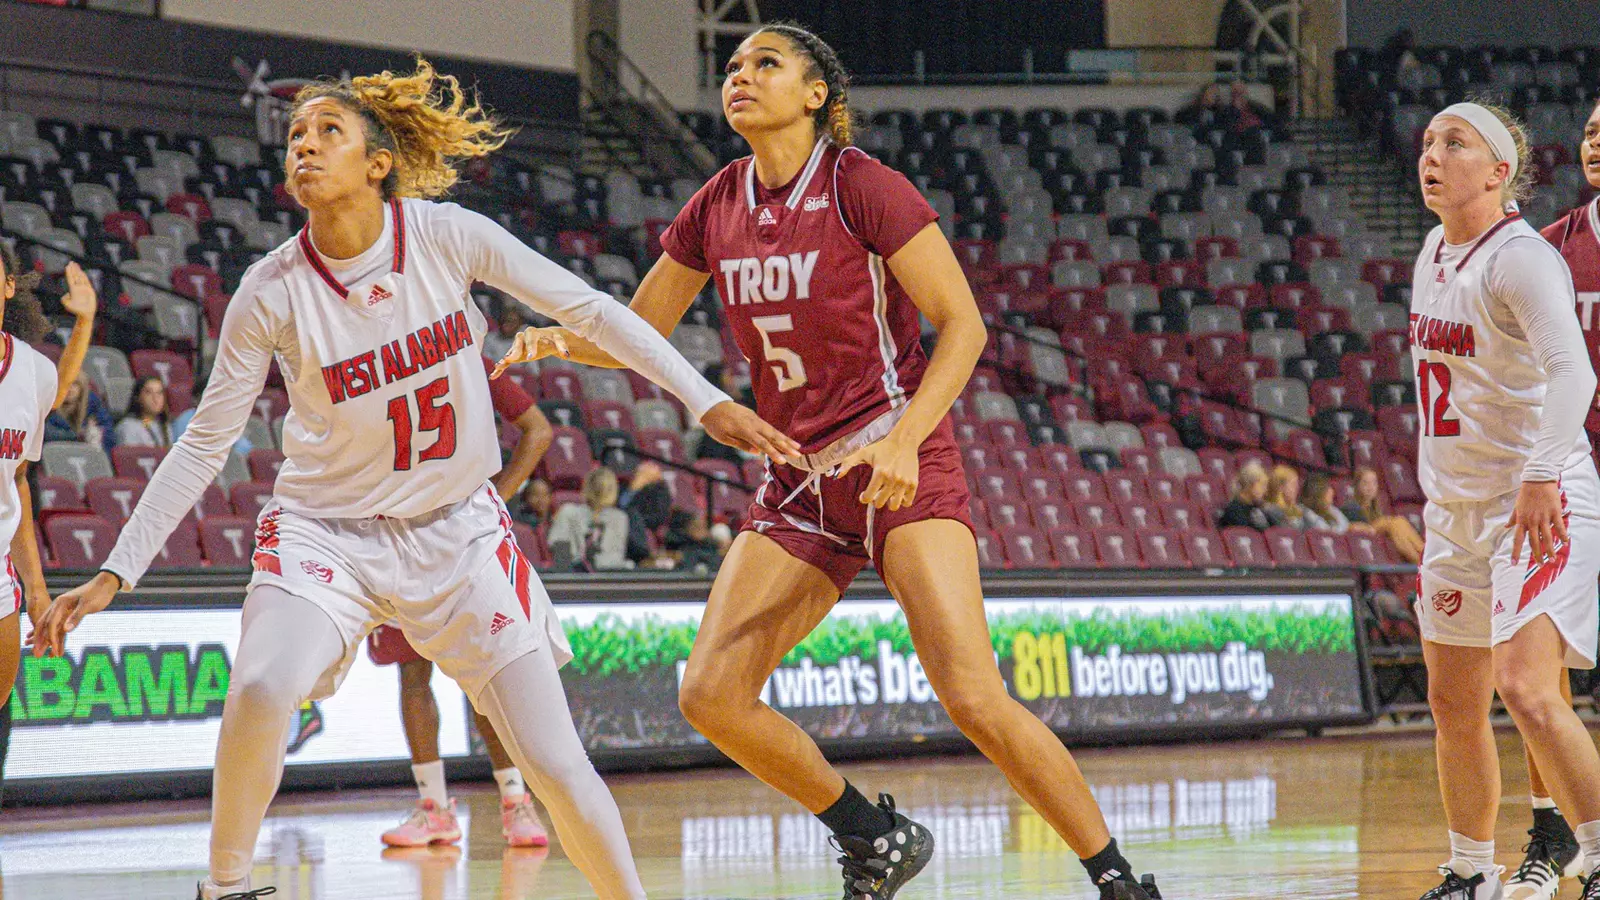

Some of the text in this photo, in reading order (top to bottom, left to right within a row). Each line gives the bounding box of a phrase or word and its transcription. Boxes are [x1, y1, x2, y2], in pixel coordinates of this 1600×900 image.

[720, 250, 820, 306] TROY
[1576, 291, 1600, 331] T
[321, 350, 381, 405] WEST
[752, 313, 808, 393] 5
[387, 376, 457, 471] 15
[1417, 359, 1461, 437] 12
[774, 657, 879, 708] what's
[1013, 631, 1071, 699] 811
[1071, 645, 1168, 698] before
[1168, 651, 1222, 704] you
[1219, 641, 1274, 701] dig.
